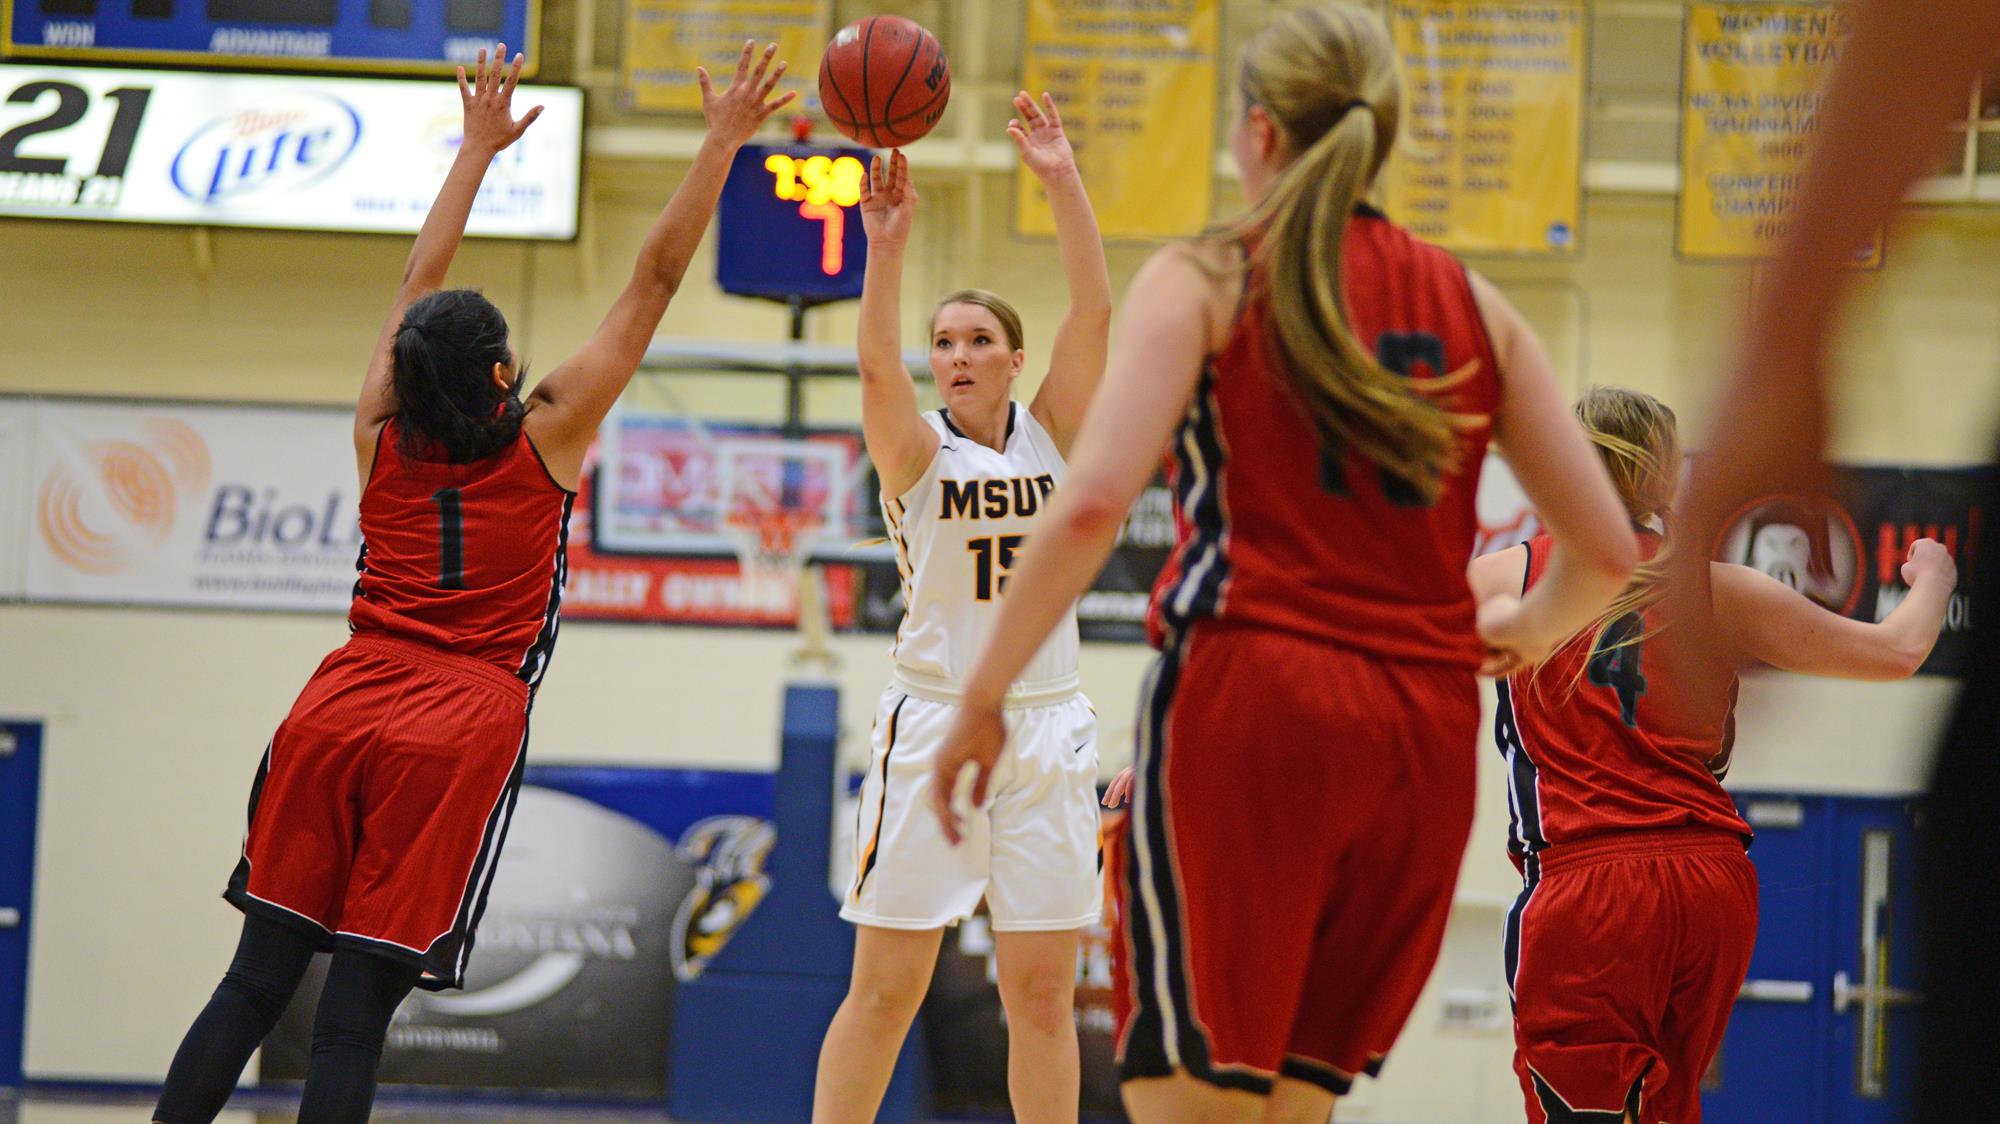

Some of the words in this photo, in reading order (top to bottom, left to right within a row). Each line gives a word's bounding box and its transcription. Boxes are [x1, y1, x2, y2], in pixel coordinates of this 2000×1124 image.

[209, 28, 332, 57] ADVANTAGE
[1696, 39, 1843, 65] VOLLEYBA
[0, 80, 153, 176] 21
[799, 201, 845, 276] 7
[206, 483, 361, 547] BioL
[431, 487, 464, 590] 1
[1588, 611, 1649, 729] 4
